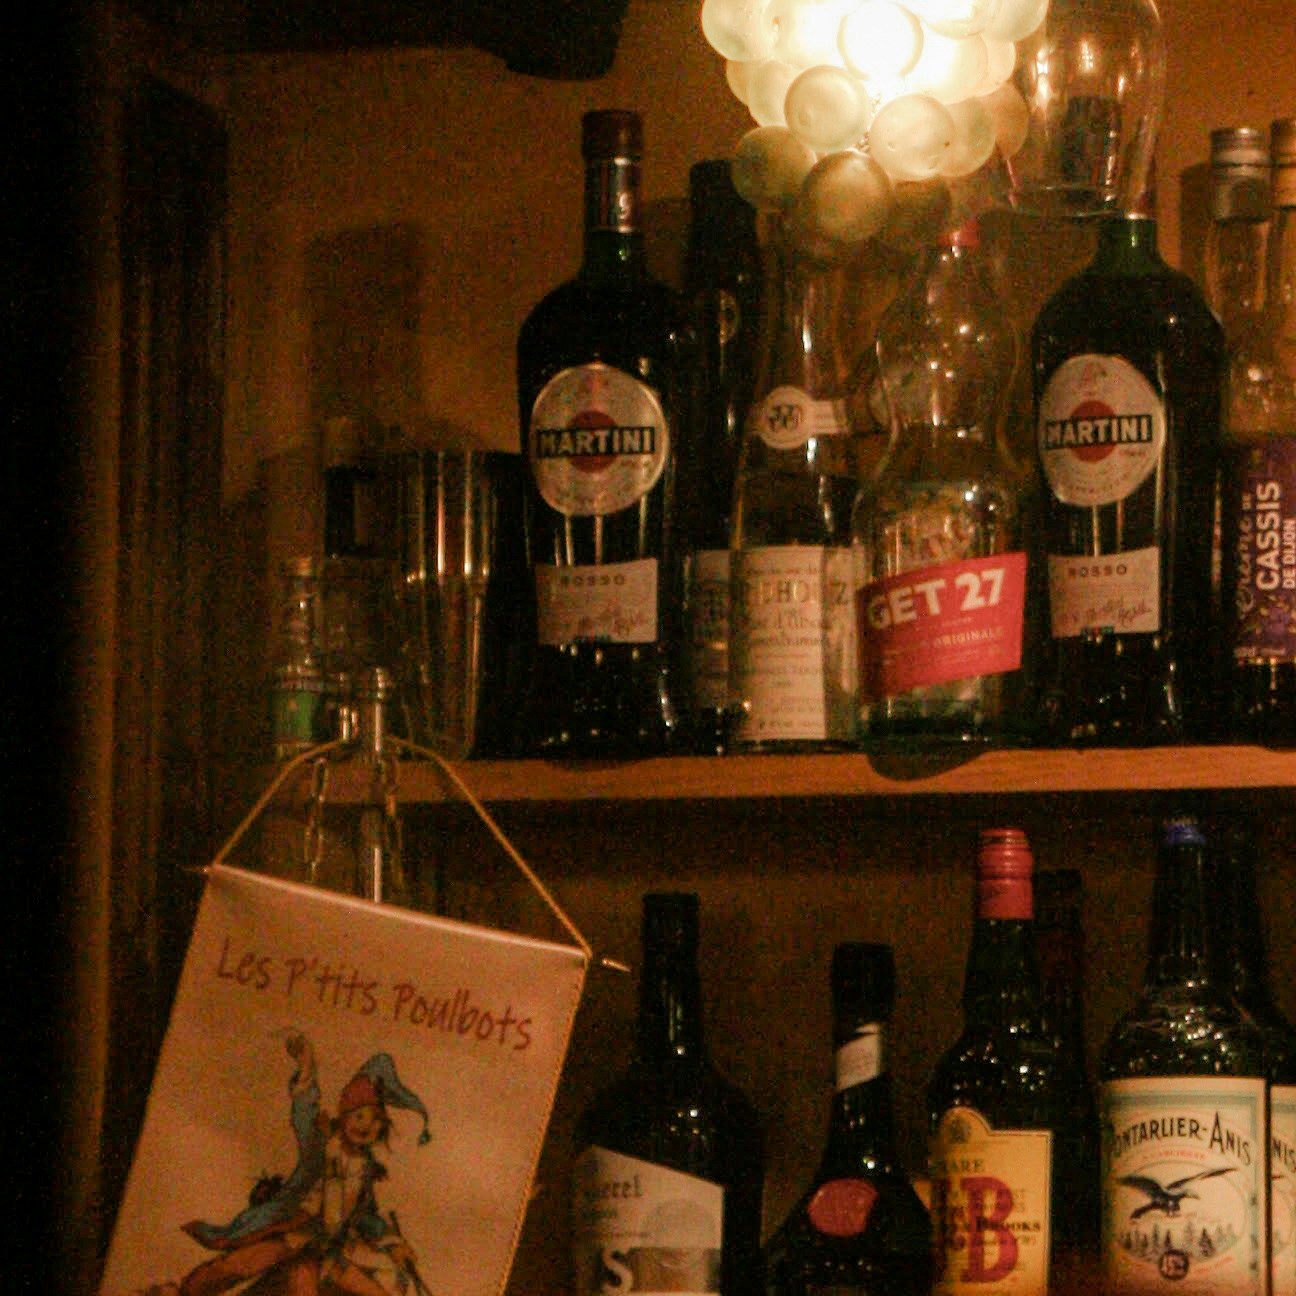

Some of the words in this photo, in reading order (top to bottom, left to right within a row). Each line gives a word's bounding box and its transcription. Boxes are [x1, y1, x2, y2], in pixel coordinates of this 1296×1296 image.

[539, 428, 652, 456] MARTINI
[1047, 415, 1151, 446] MARTINI
[1256, 479, 1282, 591] CASSIS
[1283, 518, 1296, 565] DIJON
[1067, 563, 1128, 579] ROSSO
[1283, 567, 1296, 590] DE
[866, 578, 947, 631] GET
[954, 567, 1006, 613] 27
[216, 936, 272, 990] Les
[284, 957, 379, 1016] P'tits
[392, 981, 533, 1051] Poulbots
